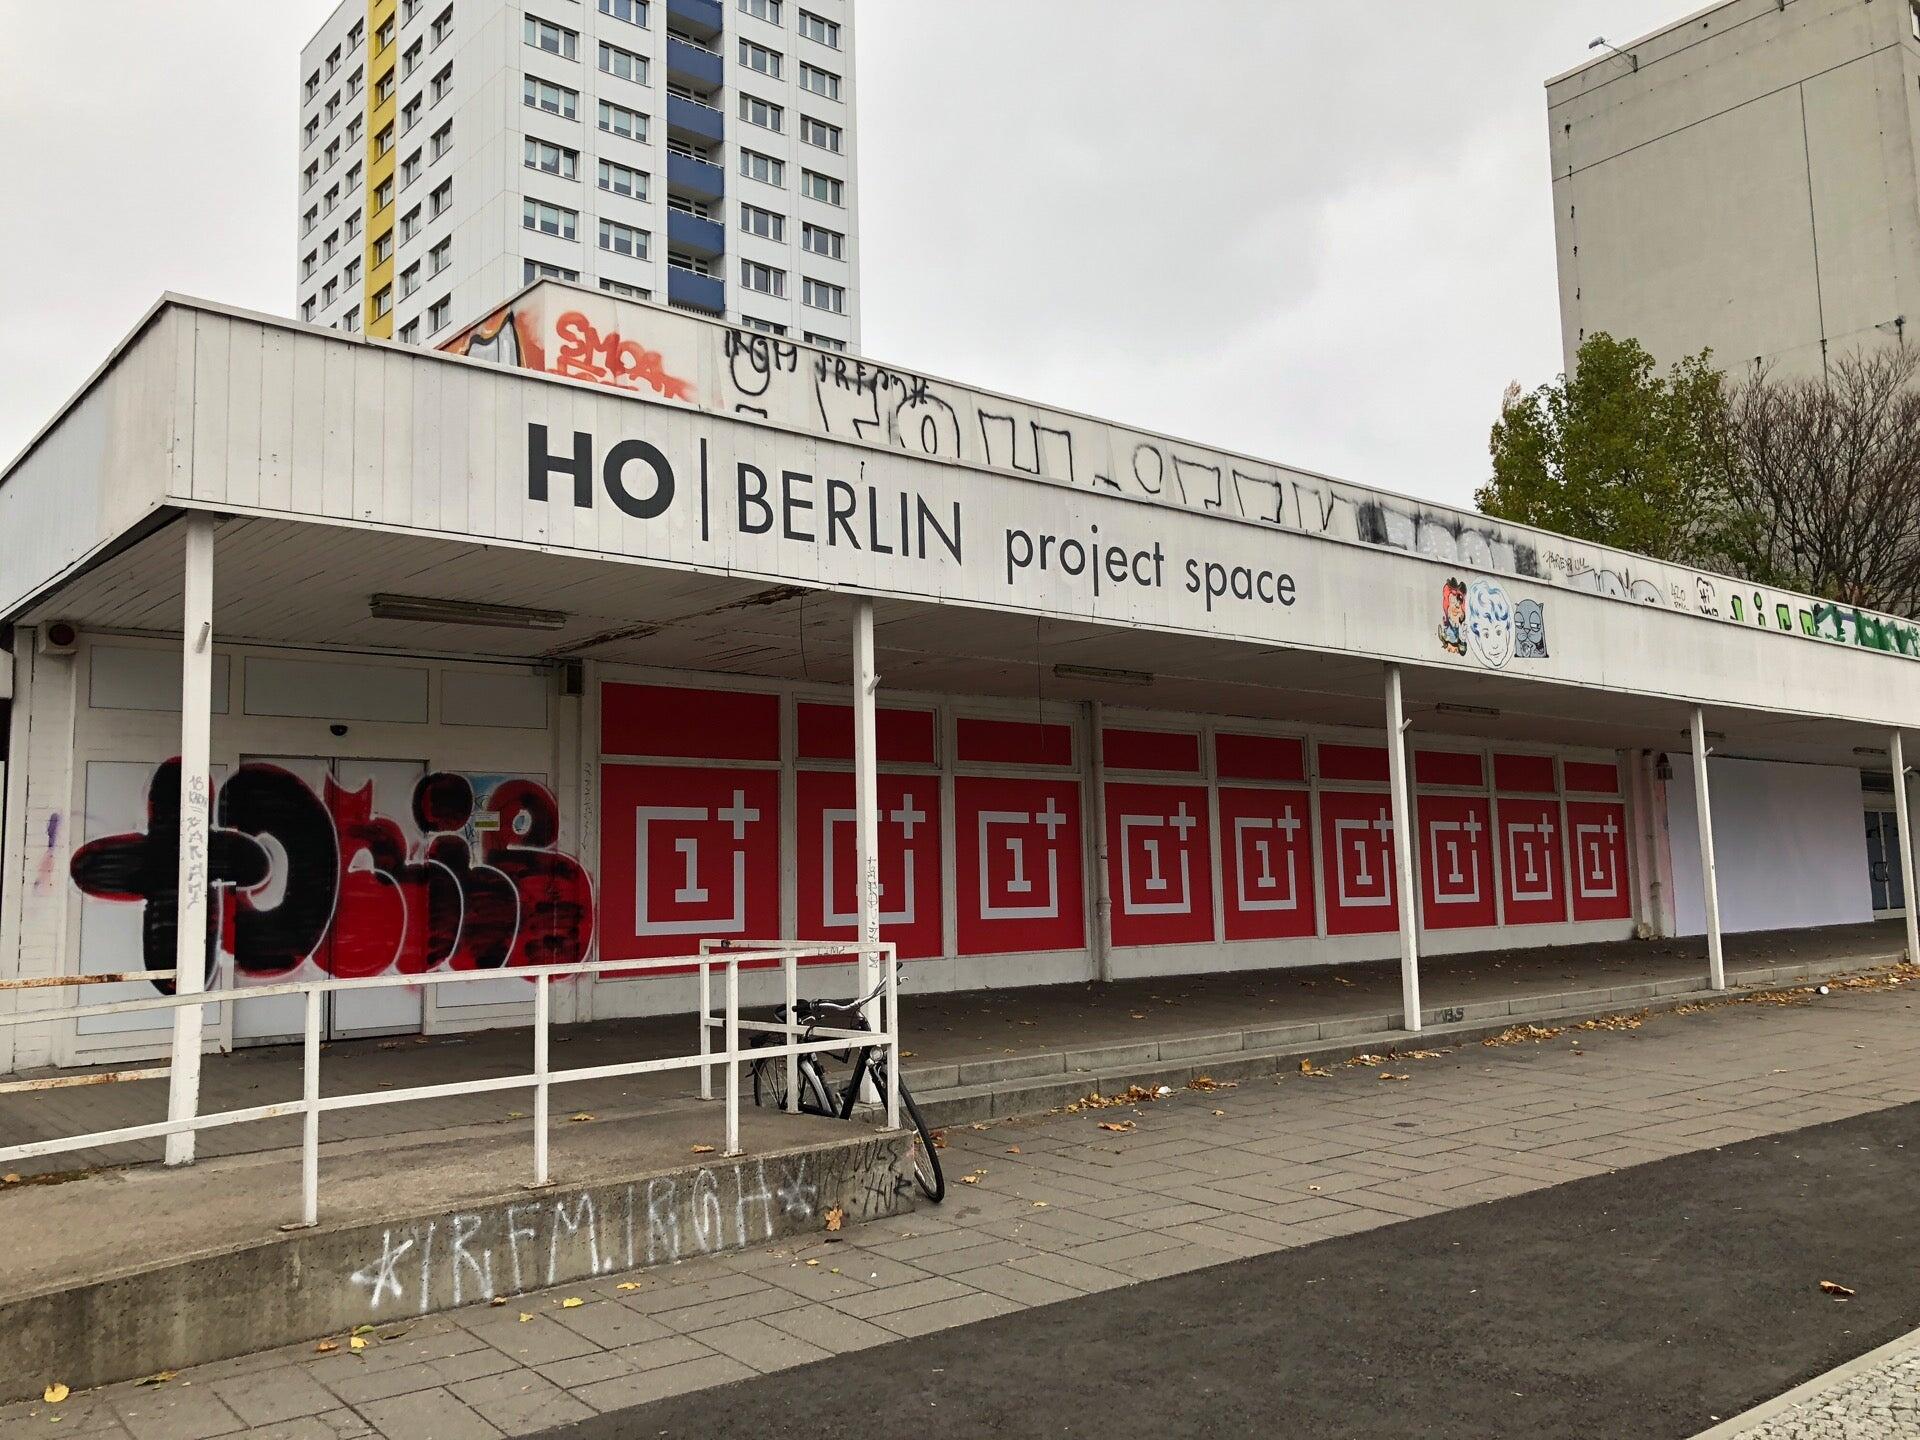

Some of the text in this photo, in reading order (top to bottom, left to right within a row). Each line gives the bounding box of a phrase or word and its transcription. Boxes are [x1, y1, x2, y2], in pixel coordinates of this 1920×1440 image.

[528, 422, 1296, 612] HO BERLIN project space
